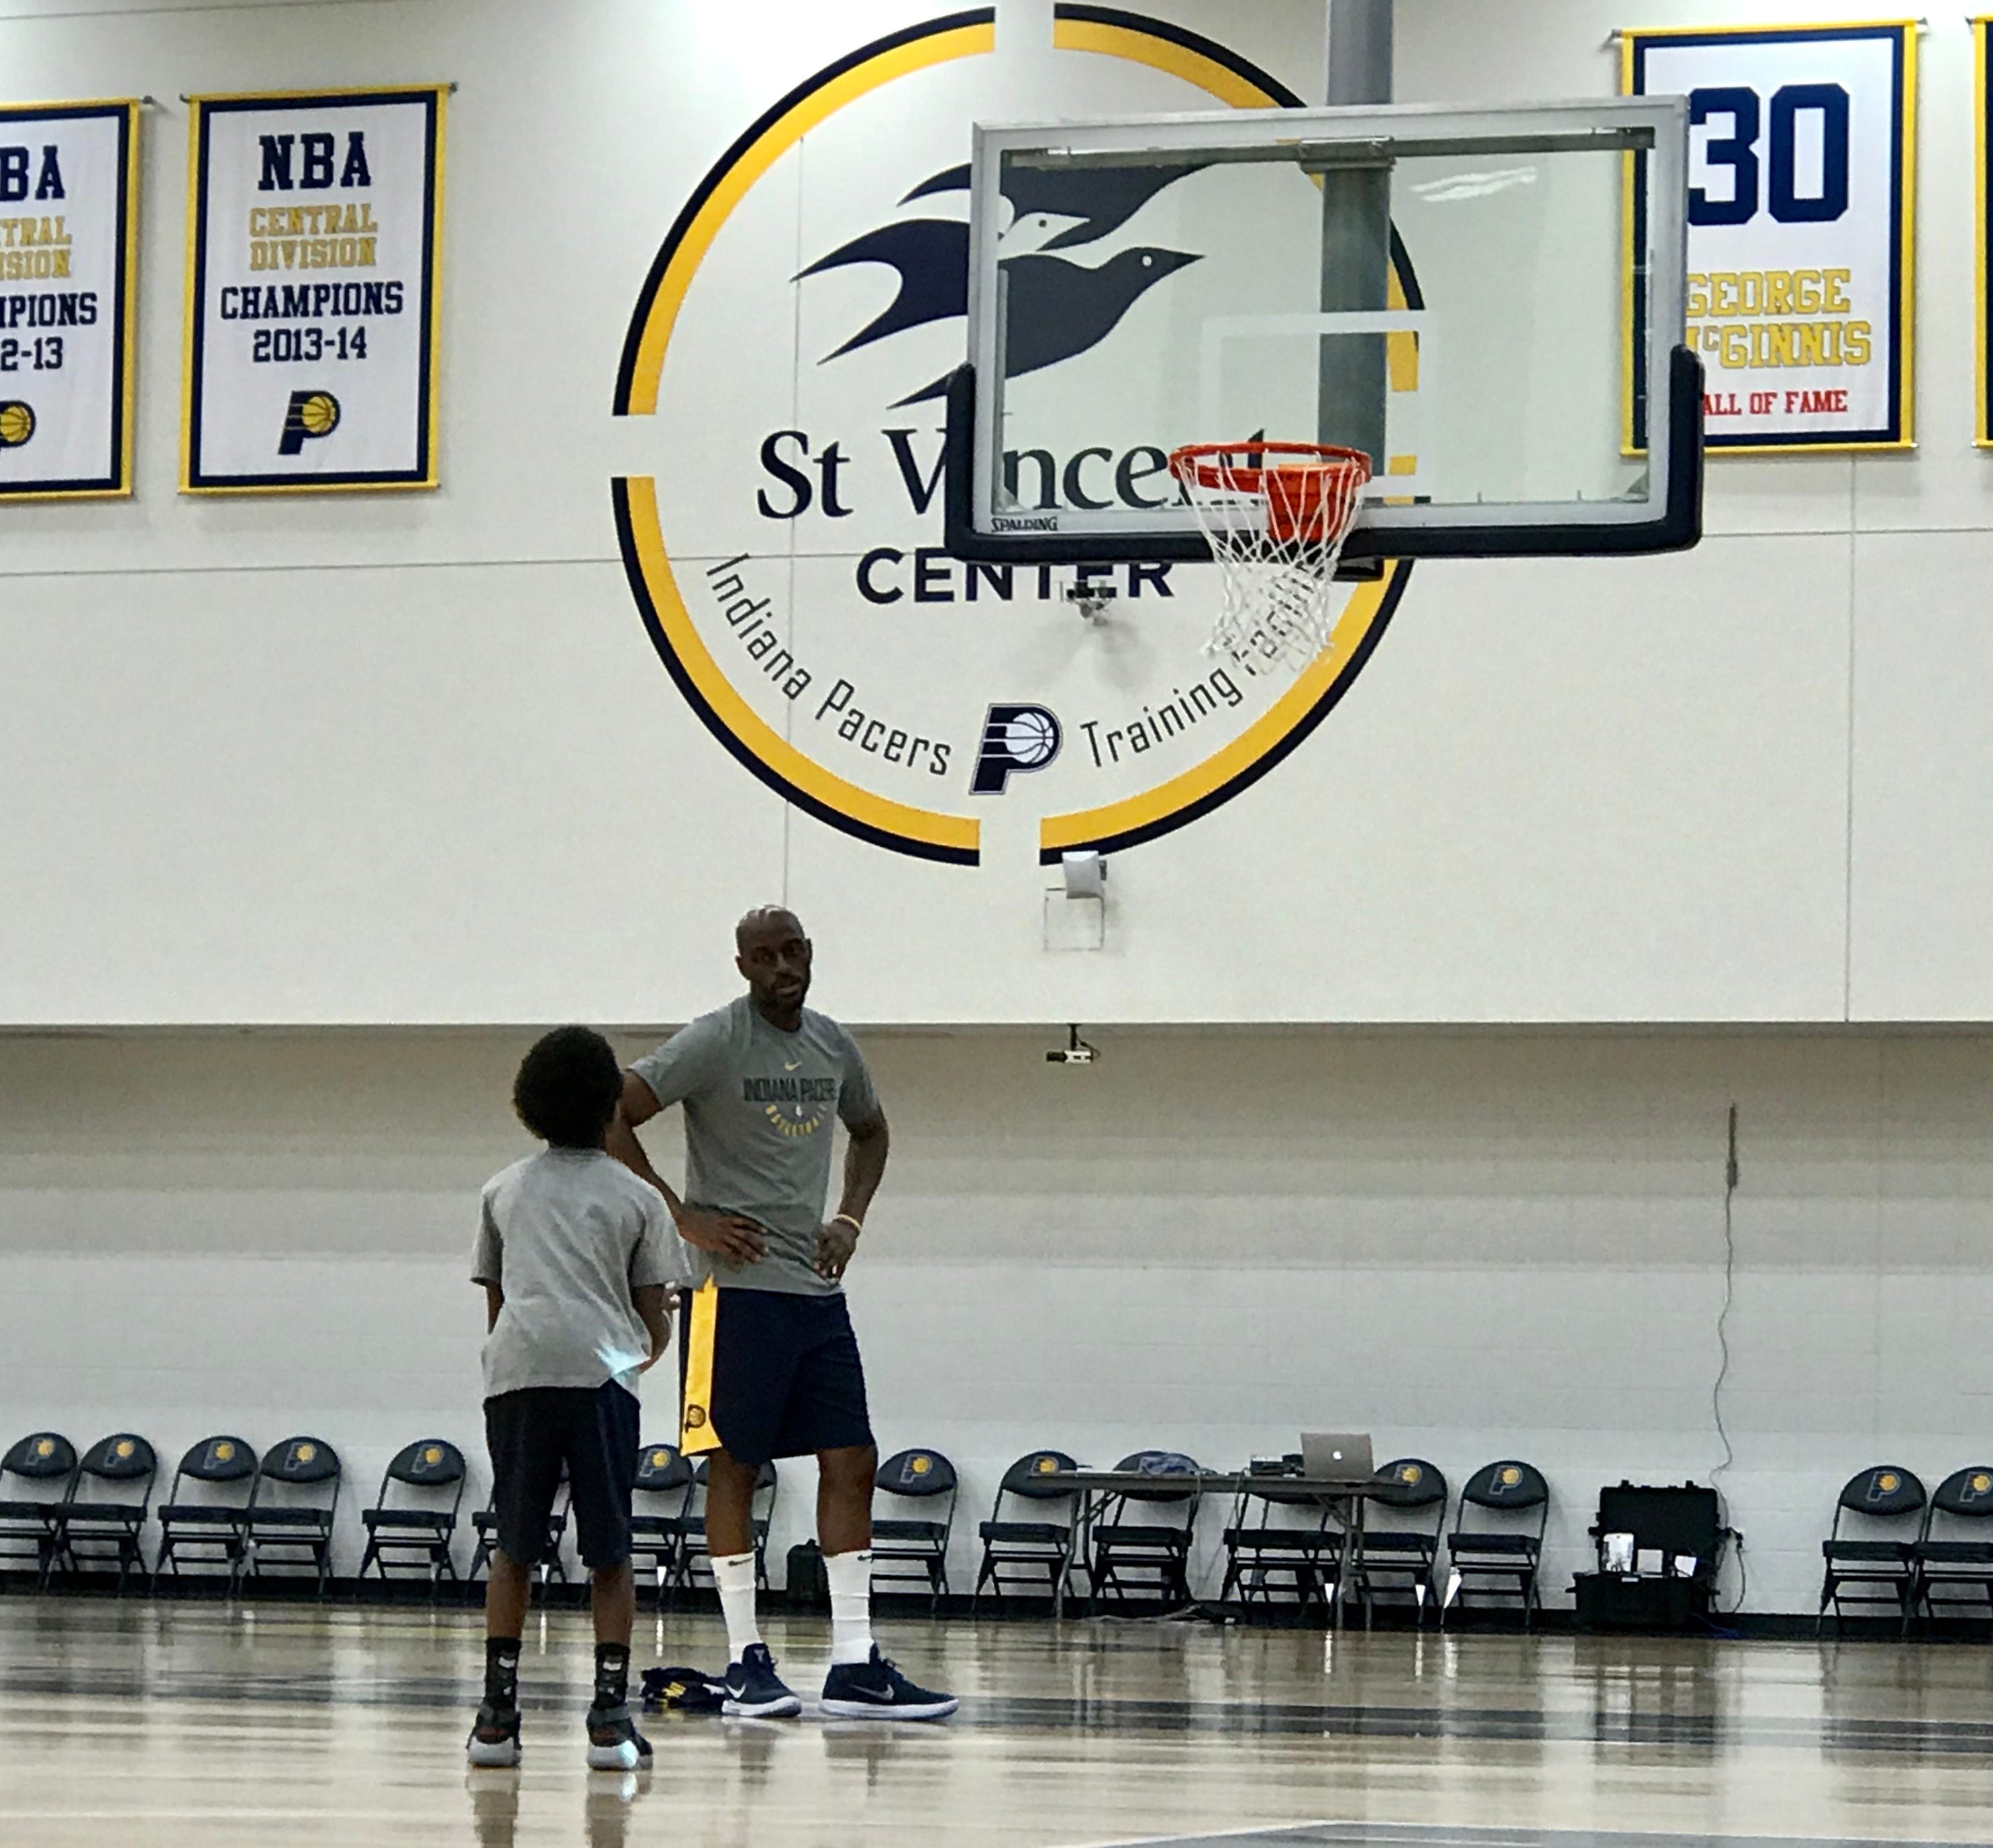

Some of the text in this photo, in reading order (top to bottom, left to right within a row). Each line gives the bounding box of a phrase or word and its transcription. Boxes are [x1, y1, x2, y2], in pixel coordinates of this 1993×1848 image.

[258, 132, 371, 191] NBA
[1687, 83, 1850, 225] 30
[0, 145, 66, 201] BA
[0, 216, 72, 248] TRAL
[250, 203, 377, 238] CENTRAL
[250, 238, 377, 270] DIVISION
[0, 292, 97, 328] PIONS
[220, 281, 403, 319] CHAMPIONS
[1686, 268, 1850, 317] GEORGE
[0, 336, 63, 371] 2-13
[252, 326, 368, 362] 2013-14
[1702, 389, 1848, 416] ALL OF FAME
[757, 427, 1267, 519] St Vncent
[991, 516, 1058, 533] SPALDING
[706, 553, 812, 701] Indiana
[815, 679, 952, 776] Pacers
[1080, 668, 1243, 768] Training
